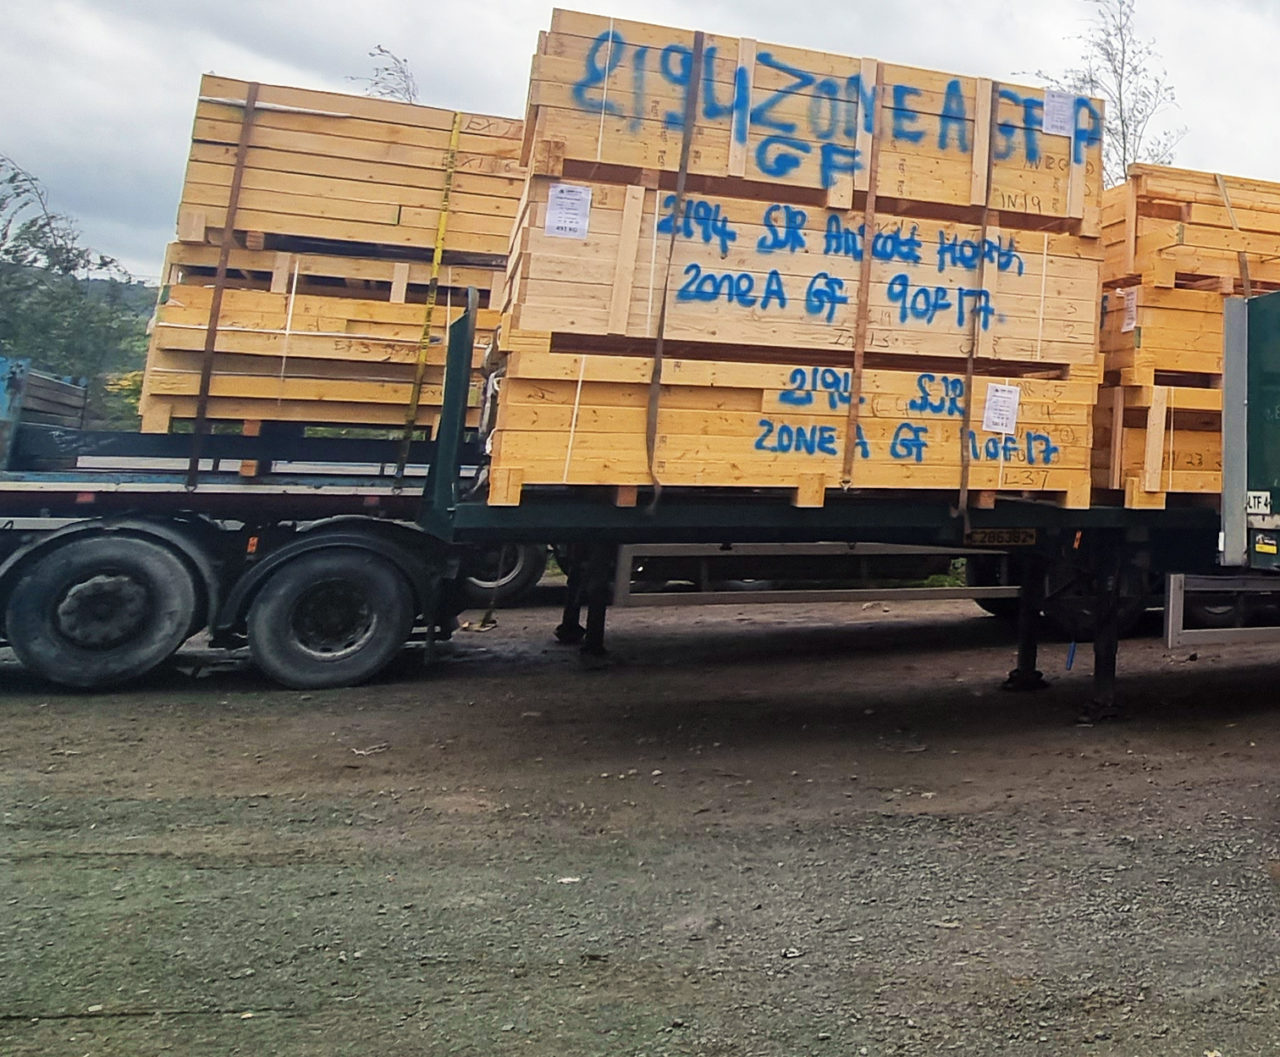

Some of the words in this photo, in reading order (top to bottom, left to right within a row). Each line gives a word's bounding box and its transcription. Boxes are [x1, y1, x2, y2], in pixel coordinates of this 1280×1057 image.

[571, 29, 750, 145] 2194
[751, 51, 925, 143] ZONE
[937, 79, 970, 154] A
[756, 134, 865, 189] GF
[657, 194, 737, 255] 2194
[806, 272, 849, 324] GF
[755, 419, 838, 456] ZONE
[890, 422, 929, 463] GF
